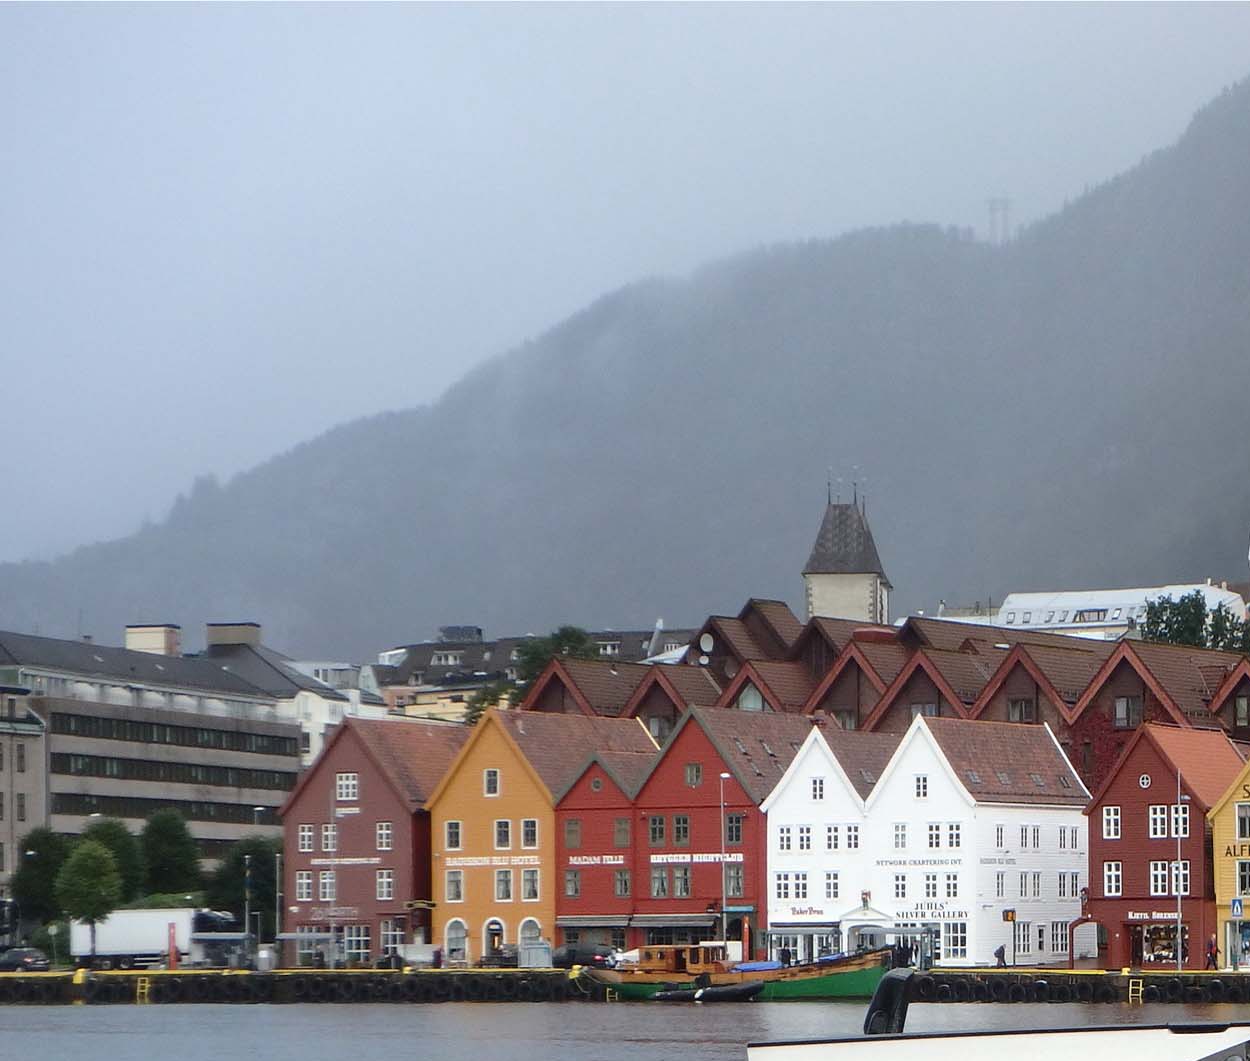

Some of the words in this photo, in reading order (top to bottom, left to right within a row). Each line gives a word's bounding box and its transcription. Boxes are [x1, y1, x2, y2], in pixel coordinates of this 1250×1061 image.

[569, 855, 600, 864] MADAM
[896, 911, 926, 919] SILVER
[931, 911, 968, 919] GALLERY
